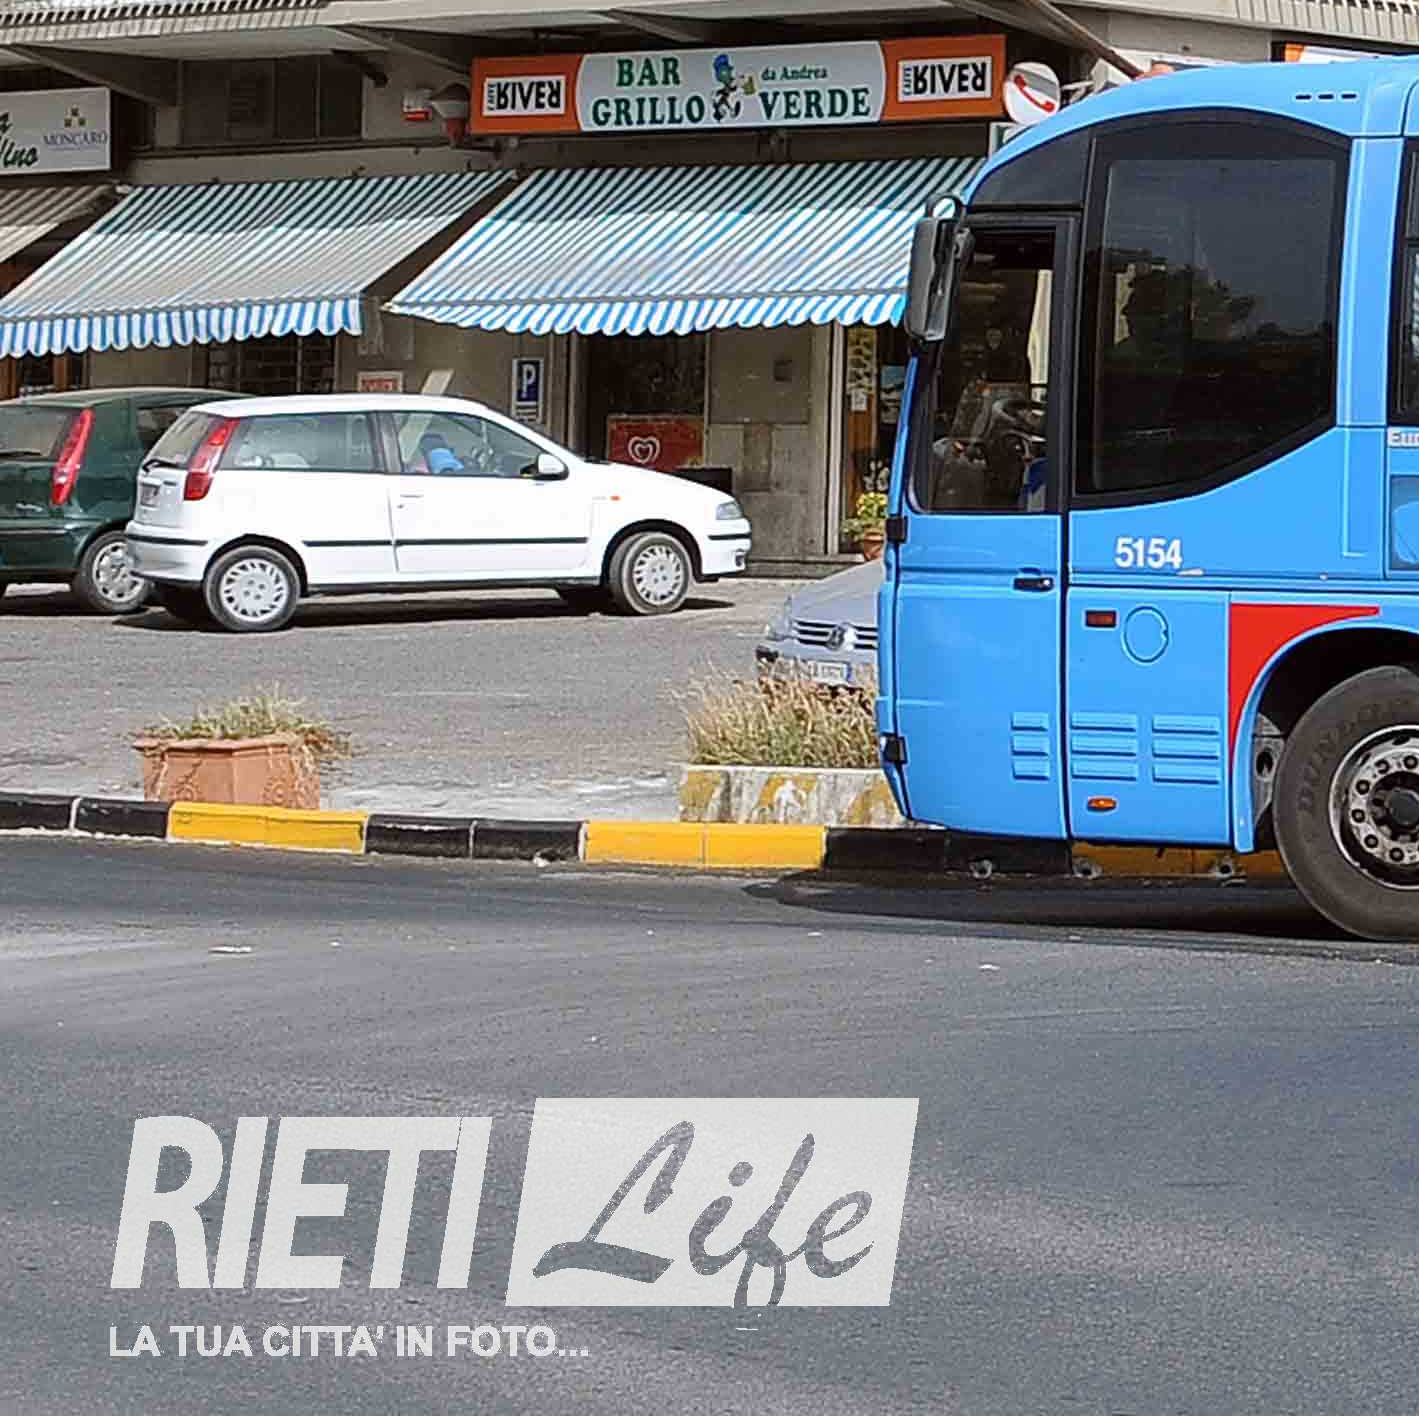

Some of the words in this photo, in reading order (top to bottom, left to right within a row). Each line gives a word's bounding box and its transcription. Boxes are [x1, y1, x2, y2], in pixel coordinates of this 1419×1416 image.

[616, 56, 681, 87] BAR
[761, 66, 776, 81] da
[780, 63, 828, 81] Andrea
[912, 62, 986, 95] RIVER
[496, 80, 561, 110] RIVER
[592, 94, 706, 127] GRILLO
[759, 87, 871, 121] VERDE
[522, 363, 536, 398] P
[1114, 536, 1183, 569] 5154
